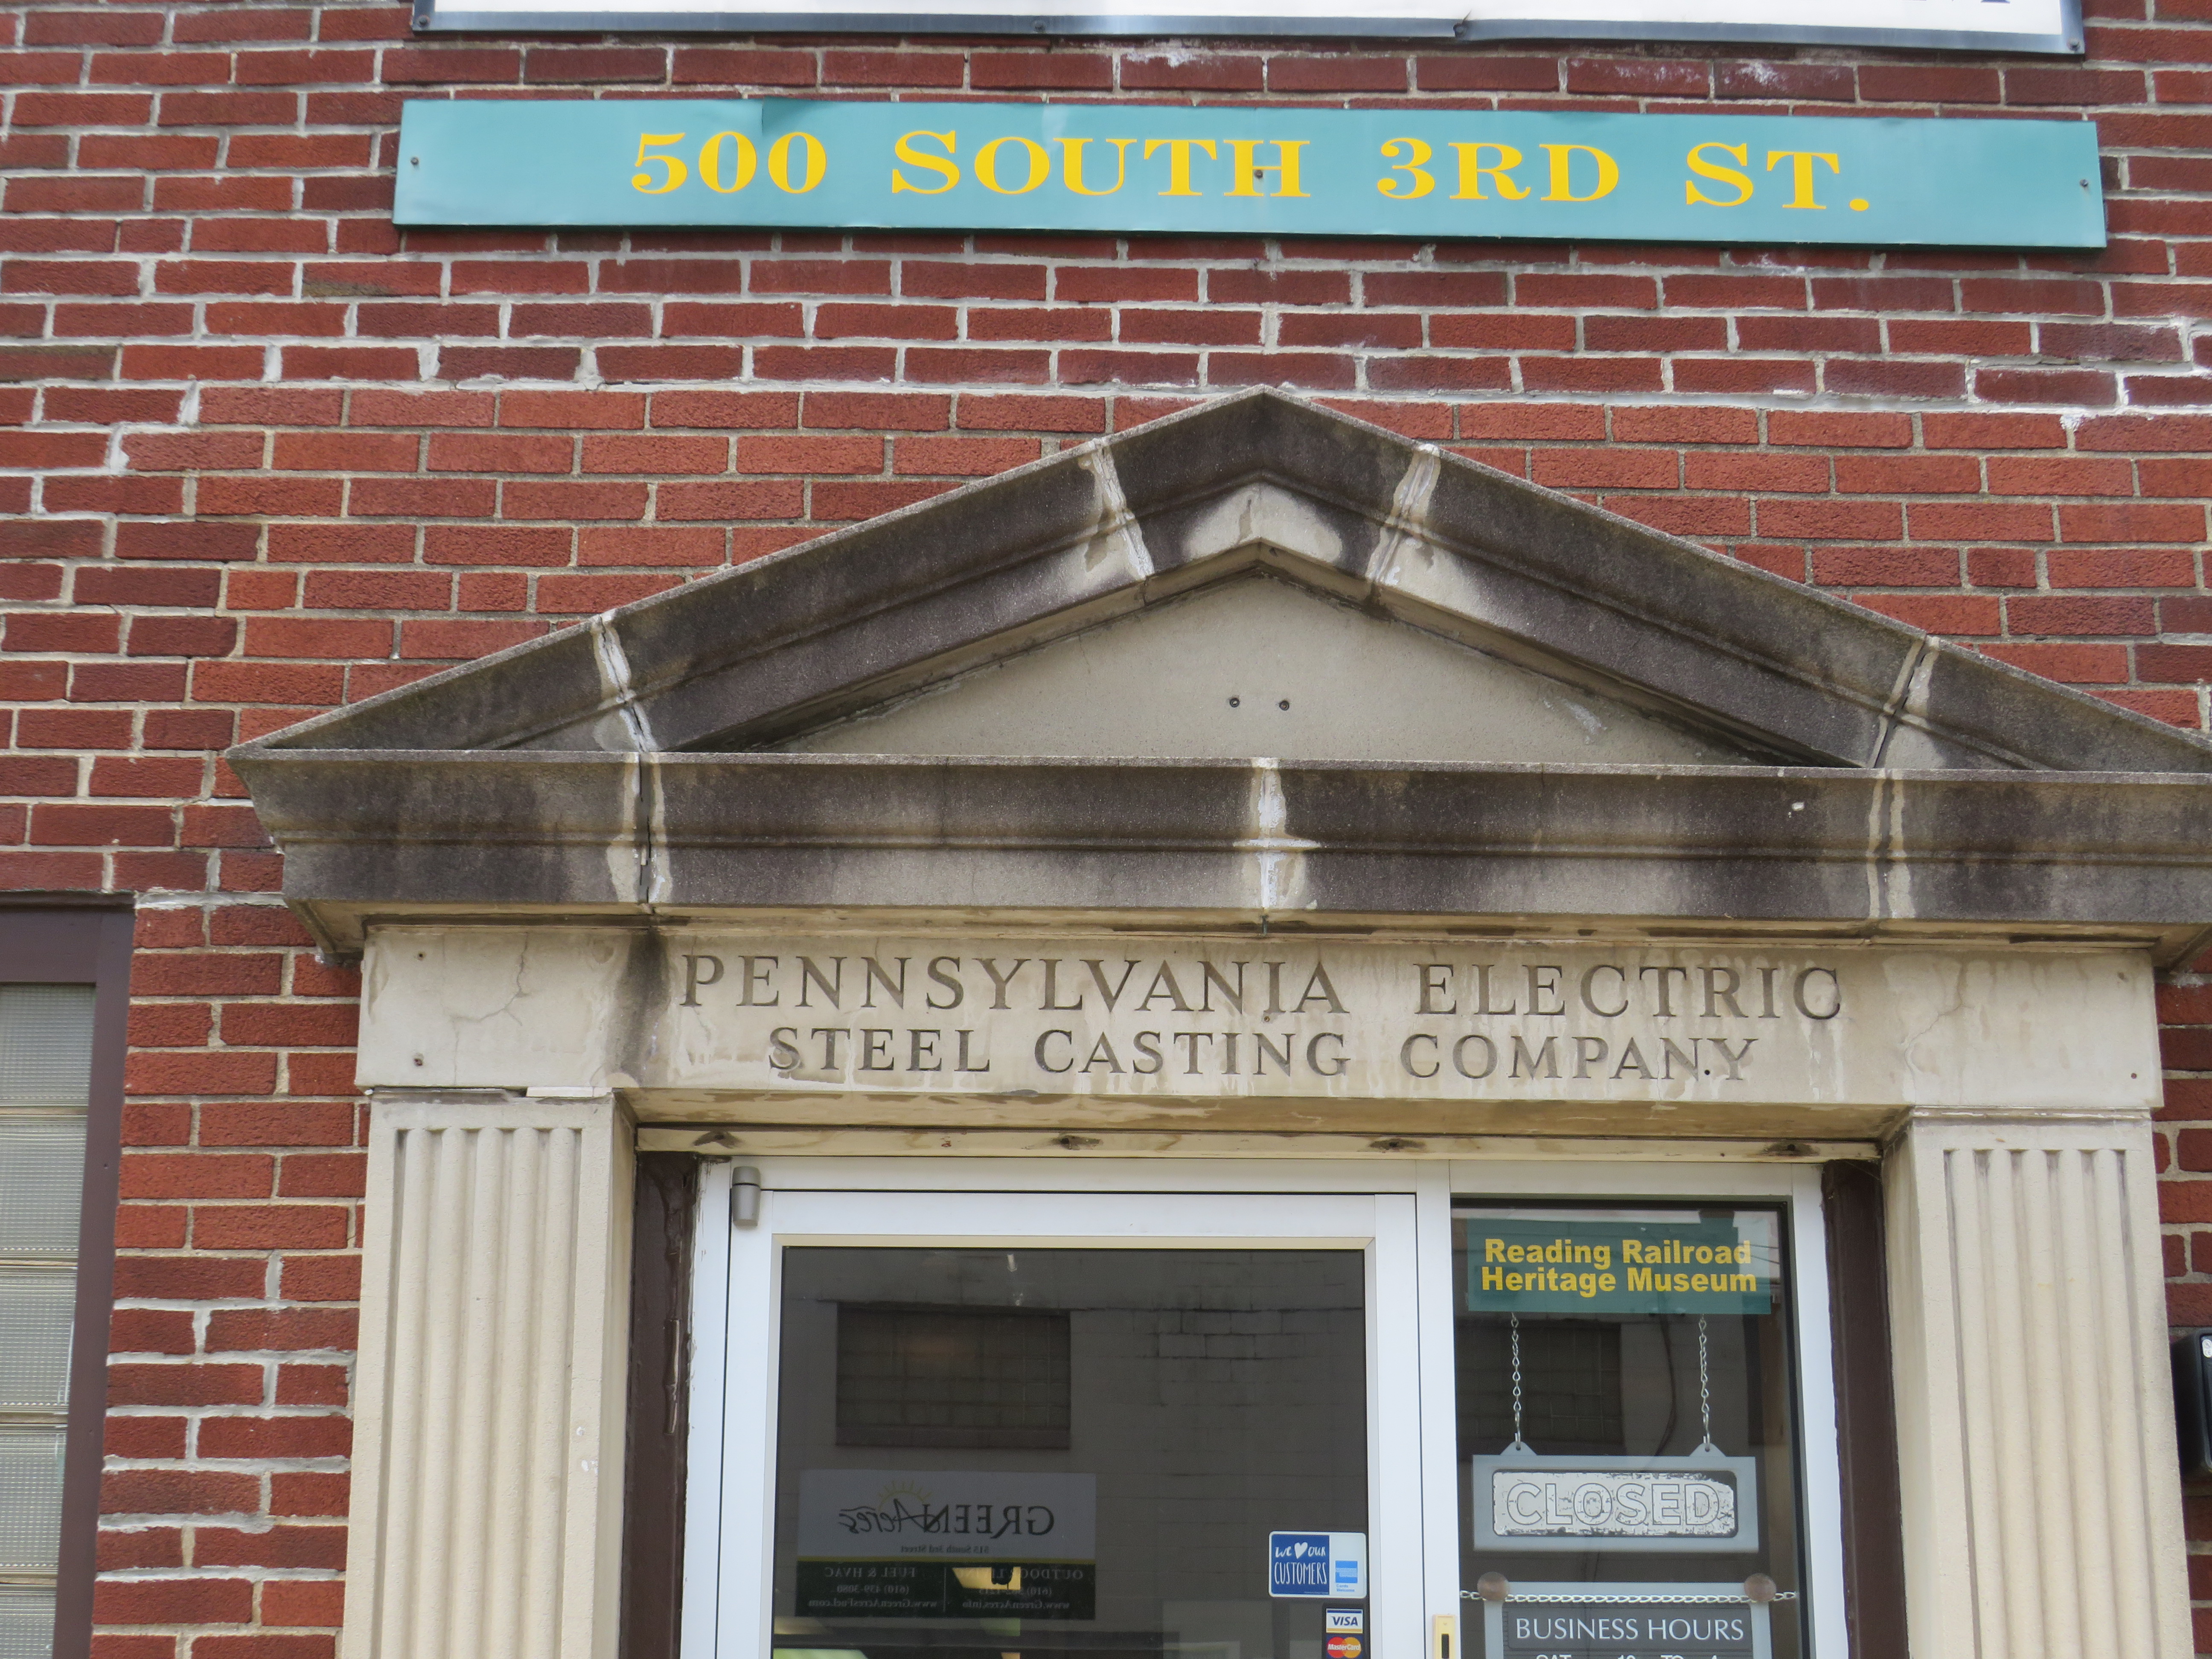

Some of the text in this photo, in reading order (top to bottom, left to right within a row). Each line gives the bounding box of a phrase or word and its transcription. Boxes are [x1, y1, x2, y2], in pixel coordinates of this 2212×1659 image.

[632, 130, 1870, 211] 500 SOUTH 3RD ST.
[680, 954, 1841, 1020] PENNSYLVANIA ELECTRIC
[768, 1027, 1759, 1081] STEEL CASTING COMPANY
[1484, 1238, 1751, 1270] Reading Railroad
[1481, 1266, 1757, 1298] Heritage Museum
[1506, 1482, 1720, 1525] CLOSED
[1274, 1561, 1327, 1585] CUSTOMERS
[1331, 1616, 1358, 1626] VISA
[1516, 1617, 1744, 1641] BUSINESS HOURS
[1327, 1643, 1360, 1651] MasterCard
